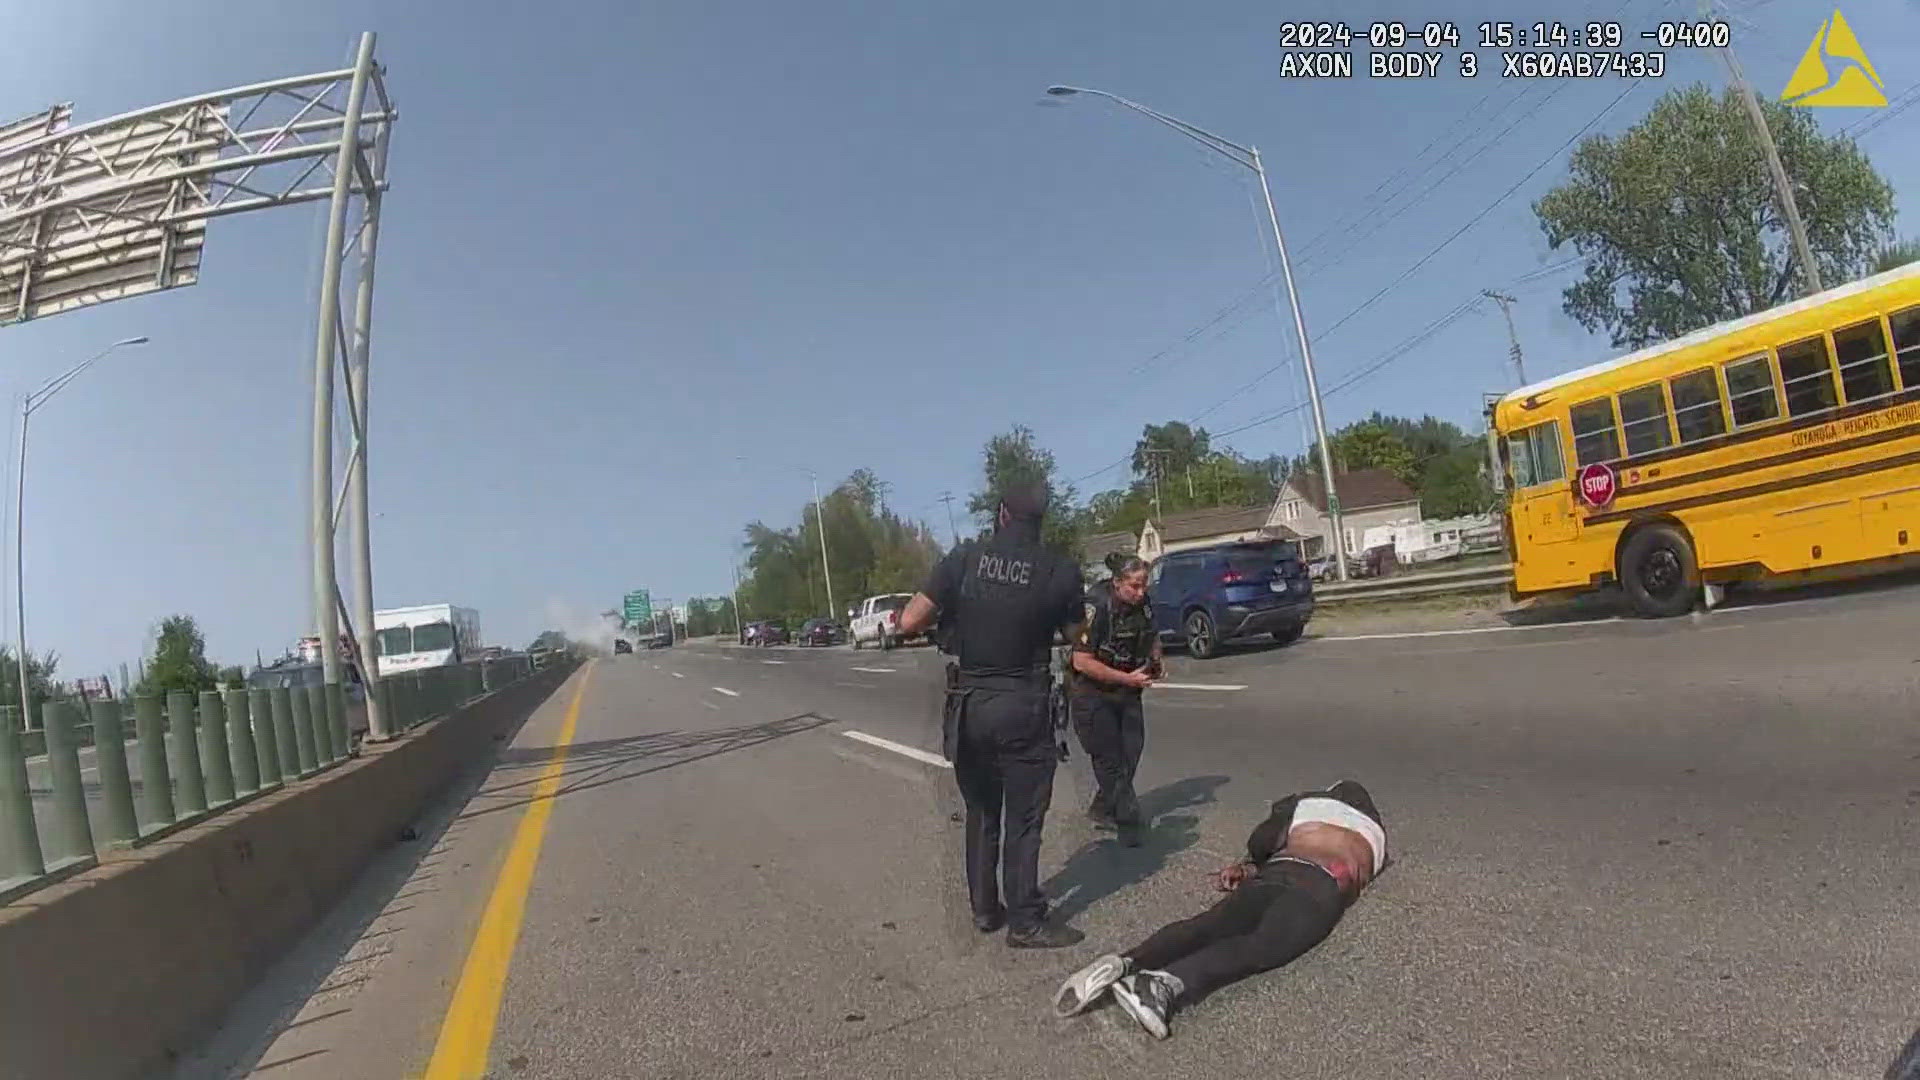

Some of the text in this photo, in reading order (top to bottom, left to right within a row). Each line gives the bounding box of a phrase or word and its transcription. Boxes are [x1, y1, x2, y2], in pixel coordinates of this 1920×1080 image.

[1791, 424, 1837, 446] CUYAHOGA
[1843, 415, 1880, 434] HEIGHTS
[1585, 475, 1609, 493] STOP
[977, 554, 1030, 585] POLICE
